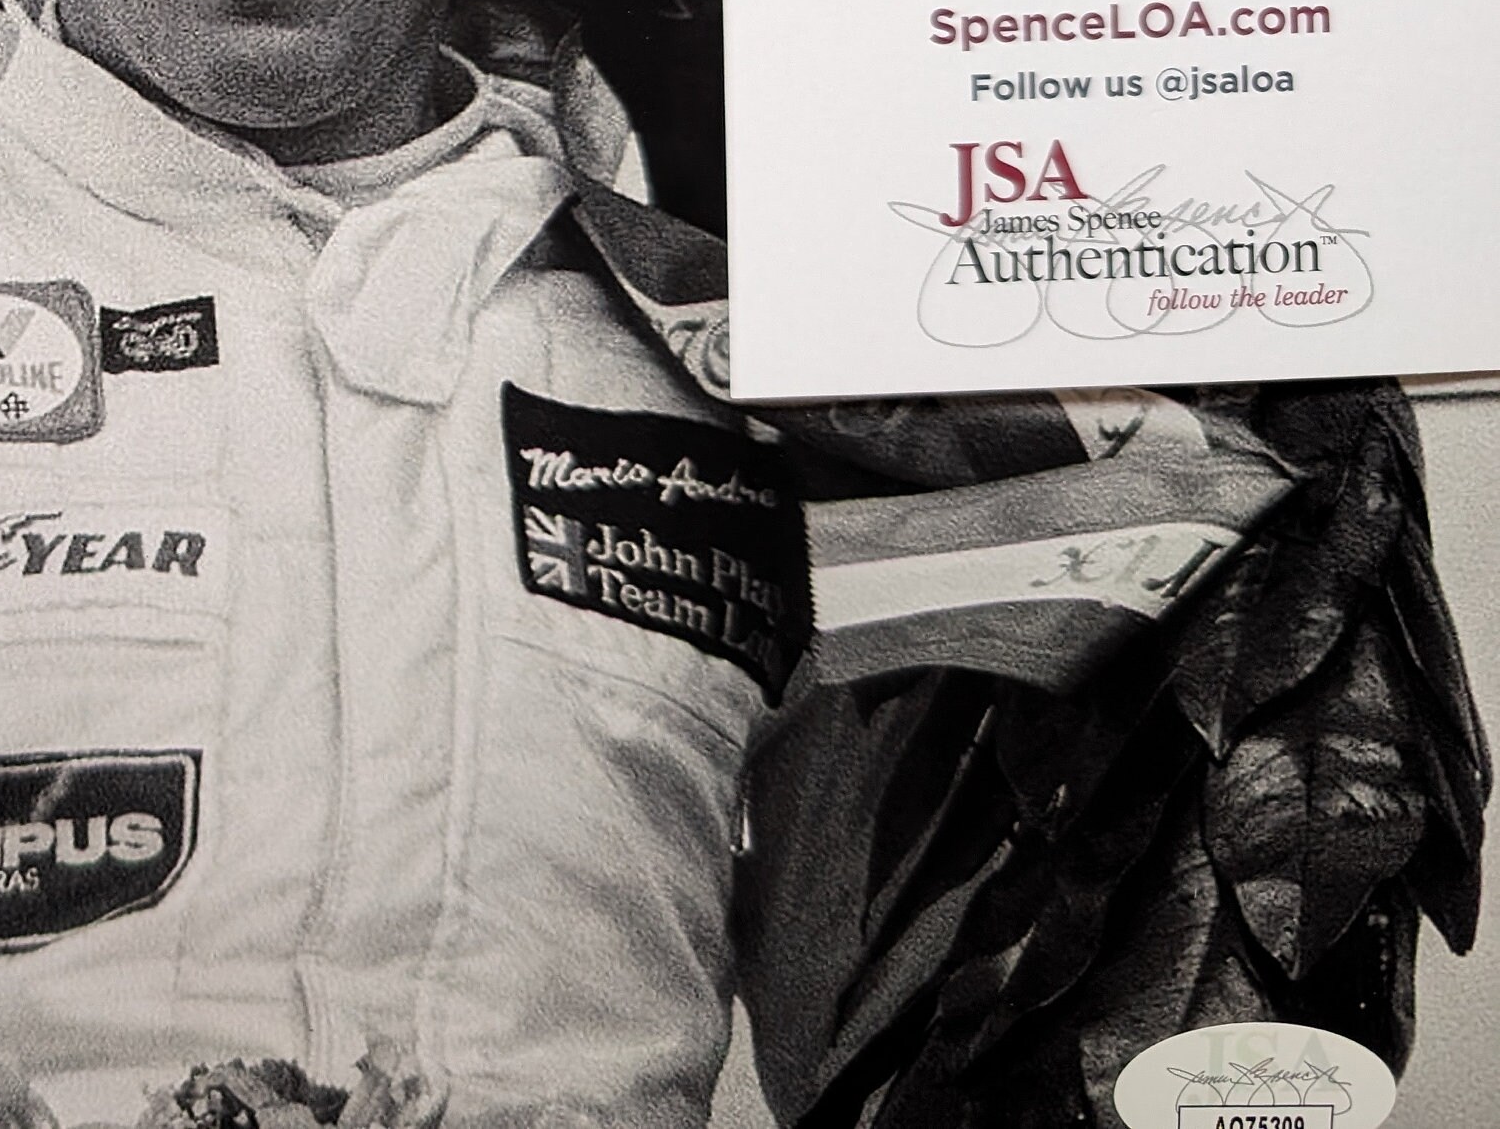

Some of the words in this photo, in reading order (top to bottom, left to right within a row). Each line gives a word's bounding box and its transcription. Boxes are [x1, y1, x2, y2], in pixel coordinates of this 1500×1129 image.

[930, 2, 1330, 51] SpenceLOA.com
[972, 72, 1091, 101] Follow
[1106, 76, 1143, 97] us
[1156, 65, 1294, 101] @jsaloa
[940, 140, 1090, 229] JSA
[980, 208, 1059, 234] James
[1067, 205, 1161, 237] Spence
[1148, 288, 1220, 316] follow
[1230, 285, 1264, 308] the
[1274, 283, 1348, 307] leader
[519, 447, 649, 490] Mario
[587, 523, 701, 581] John
[587, 565, 717, 636] Team
